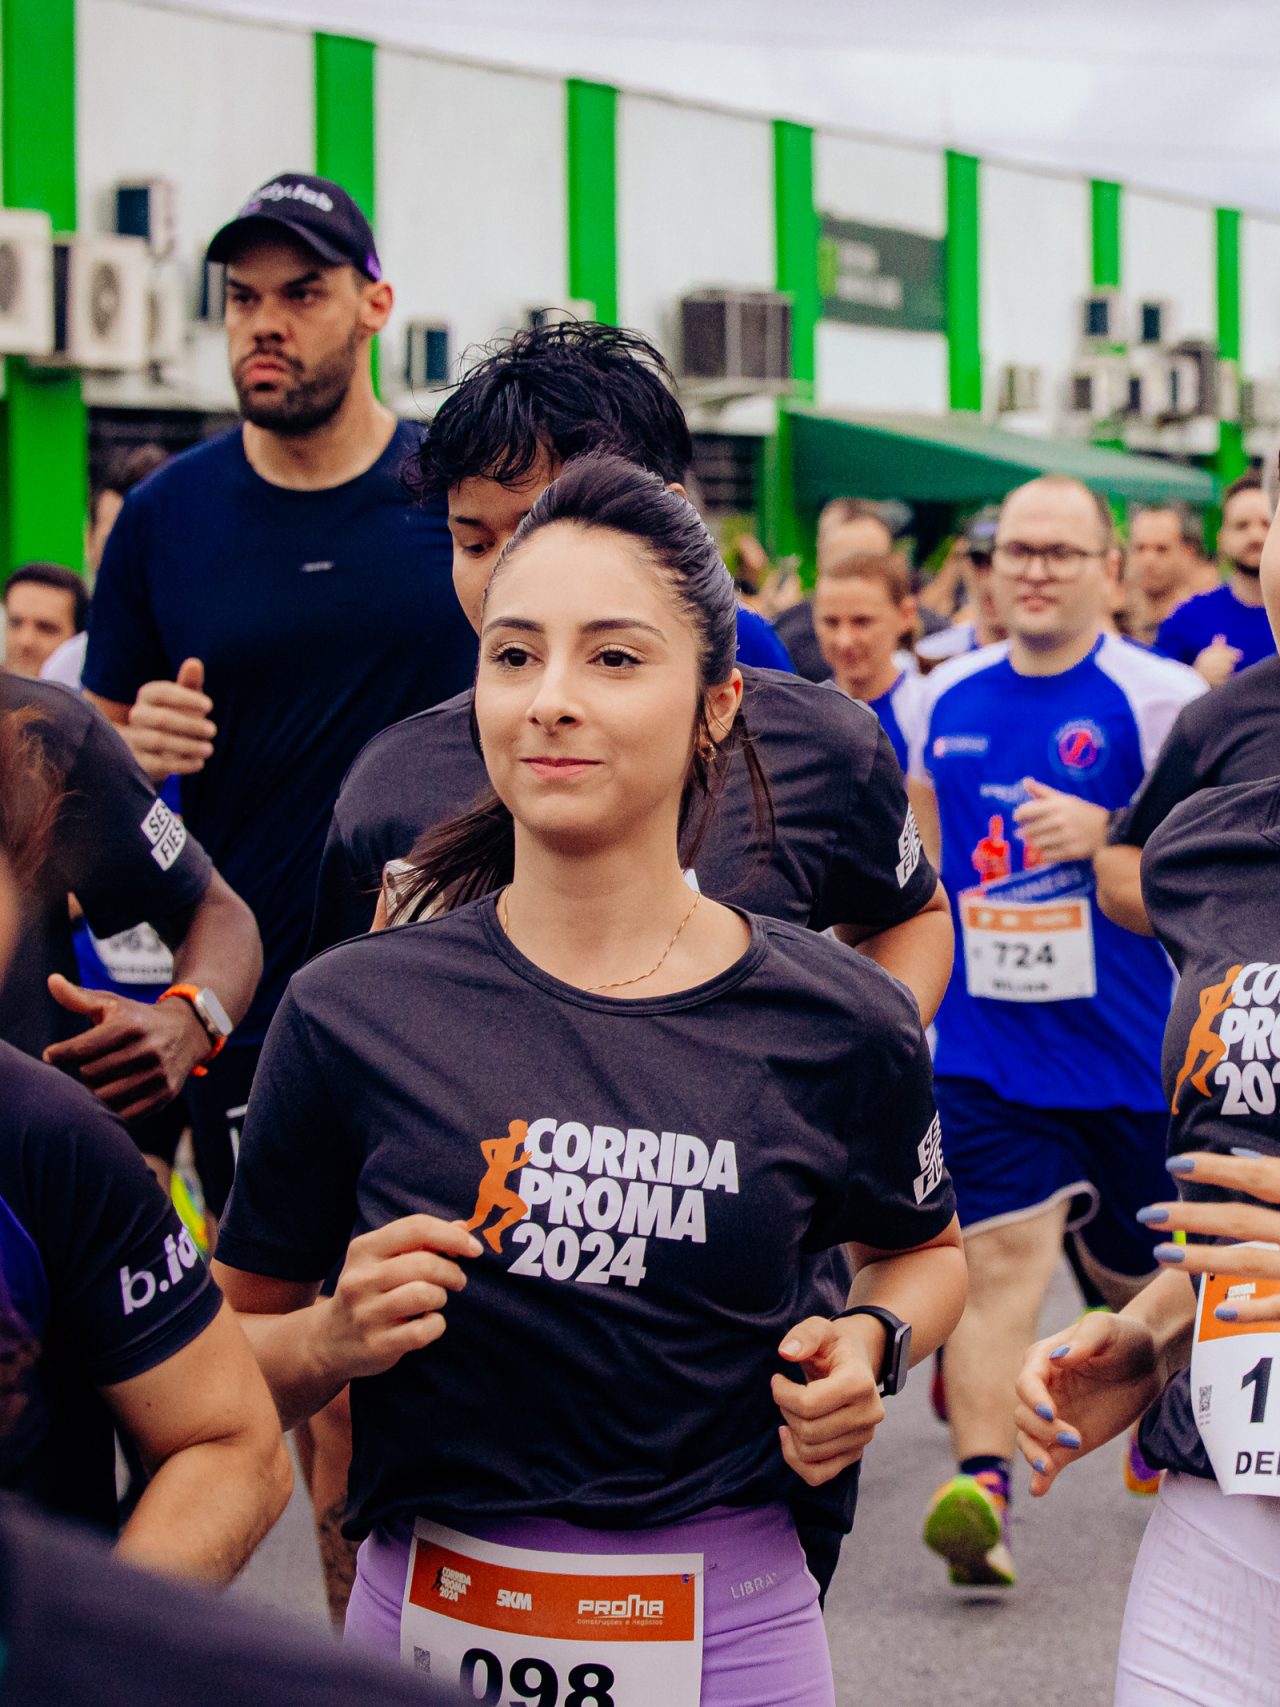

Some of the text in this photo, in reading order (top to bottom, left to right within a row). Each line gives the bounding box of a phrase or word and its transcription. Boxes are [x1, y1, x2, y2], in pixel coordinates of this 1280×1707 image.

[993, 941, 1054, 969] 724
[524, 1118, 740, 1194] CORRIDA
[518, 1167, 707, 1244] PROMA
[507, 1222, 648, 1287] 2024
[440, 1576, 467, 1596] PROMA
[442, 1566, 472, 1587] CORRIDA
[496, 1588, 532, 1611] 5KM
[578, 1594, 664, 1618] PROMA
[460, 1647, 615, 1707] 098
